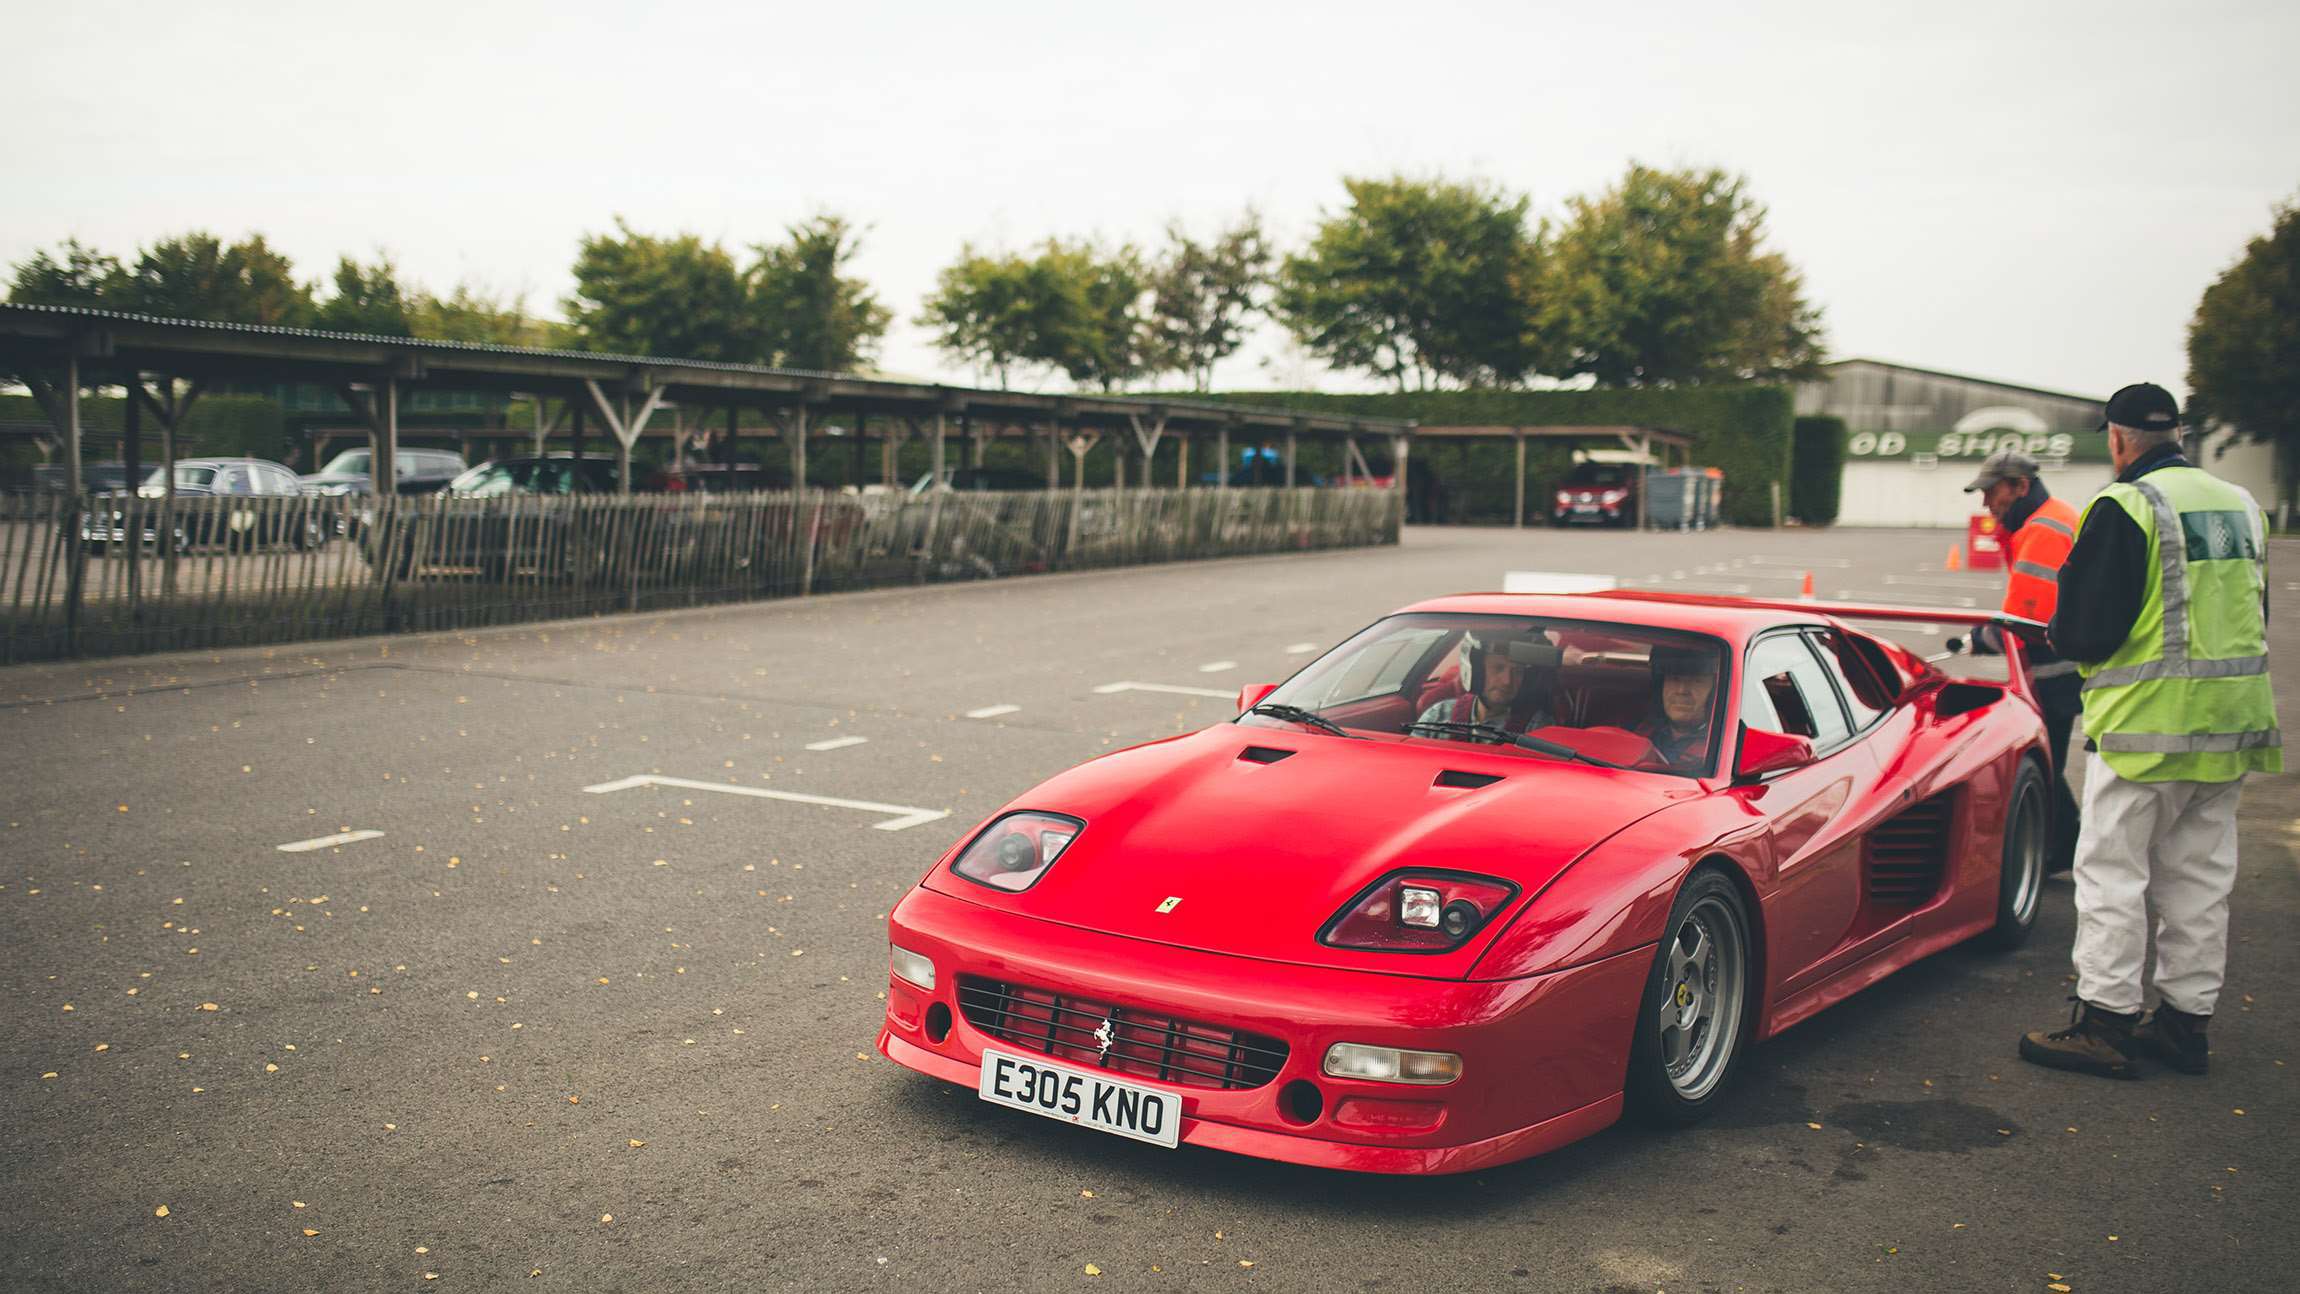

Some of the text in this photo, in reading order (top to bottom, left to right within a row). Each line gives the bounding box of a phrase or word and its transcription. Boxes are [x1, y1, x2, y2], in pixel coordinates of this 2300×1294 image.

[1848, 432, 2073, 456] OD SHOPS
[994, 1058, 1164, 1135] E305 KNO
